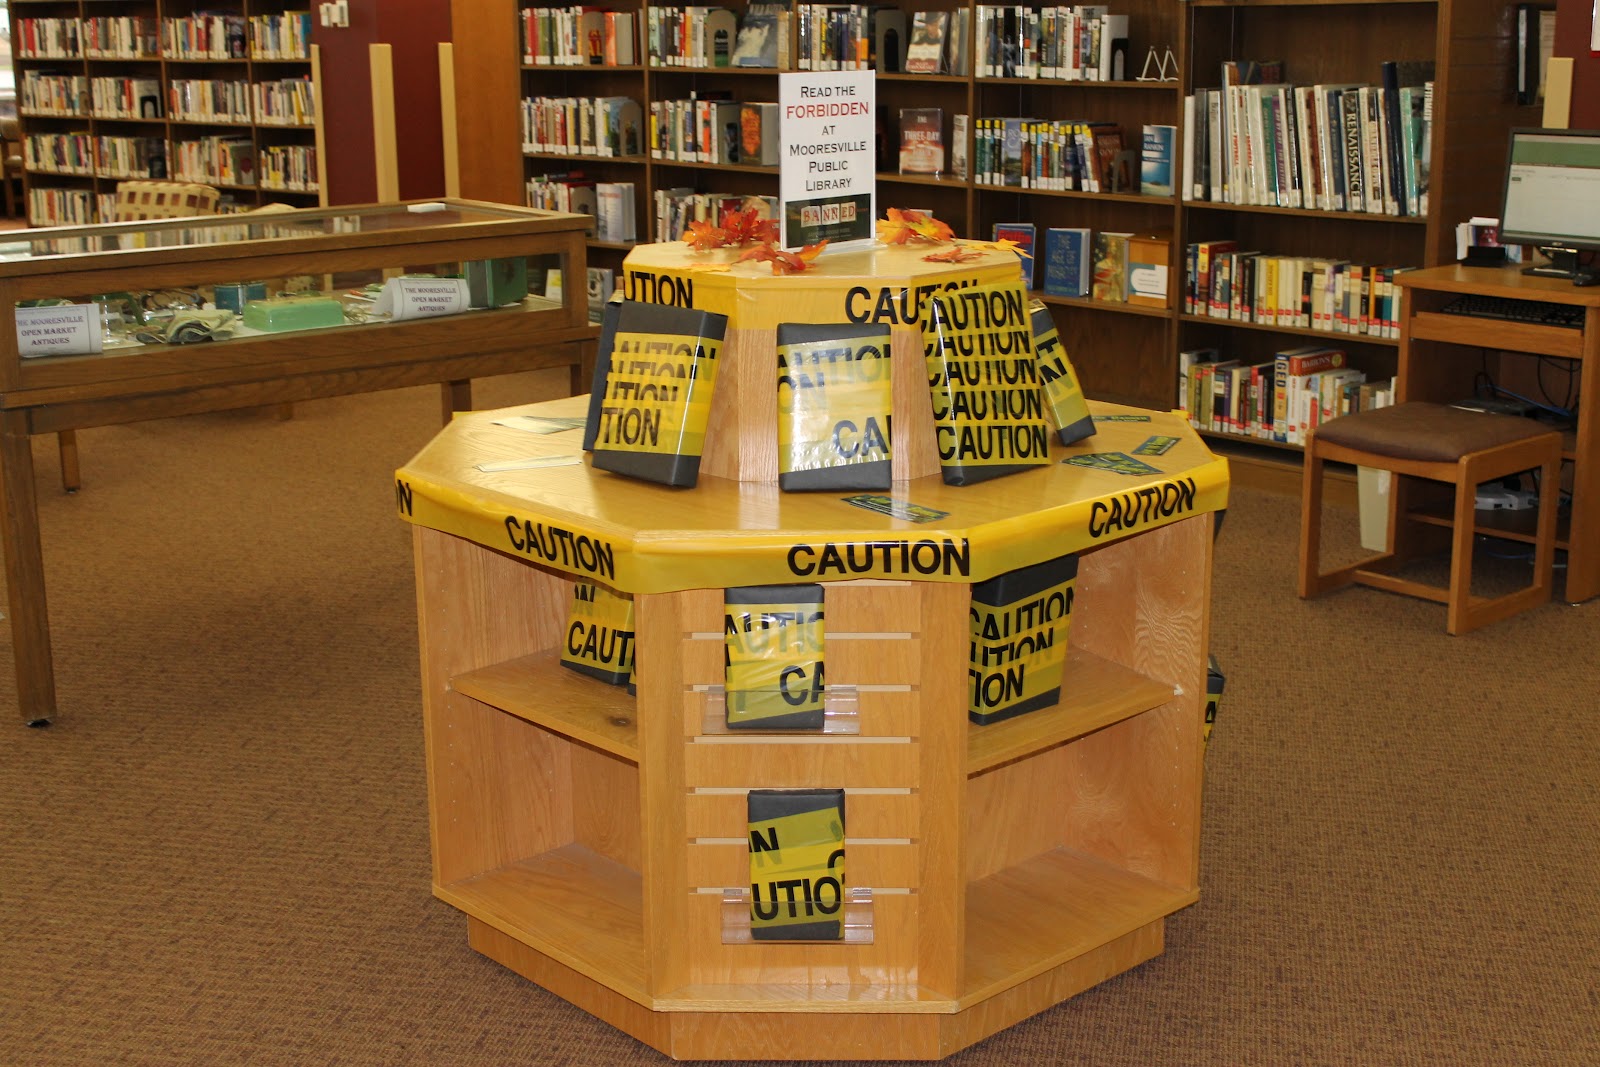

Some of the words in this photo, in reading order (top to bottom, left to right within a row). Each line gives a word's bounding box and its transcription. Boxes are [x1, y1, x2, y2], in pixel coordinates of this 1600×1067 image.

[835, 85, 856, 96] THE
[786, 102, 869, 119] FORBIDDEN
[821, 125, 836, 136] AT
[790, 141, 867, 156] MOORESVILLE
[1346, 113, 1361, 197] RENAISSANCE
[809, 160, 848, 173] PUBLIC
[806, 178, 852, 191] LIBRARY
[803, 206, 855, 222] BANNED
[30, 316, 84, 326] MOORESVILLE
[21, 328, 42, 337] OPEN
[43, 326, 77, 335] MARKET
[31, 337, 70, 346] ANTIQUES
[1276, 362, 1287, 388] GED
[936, 424, 1049, 460] CAUTION
[1088, 477, 1197, 538] CAUTION
[504, 515, 615, 581] CAUTION
[787, 537, 970, 577] CAUTION
